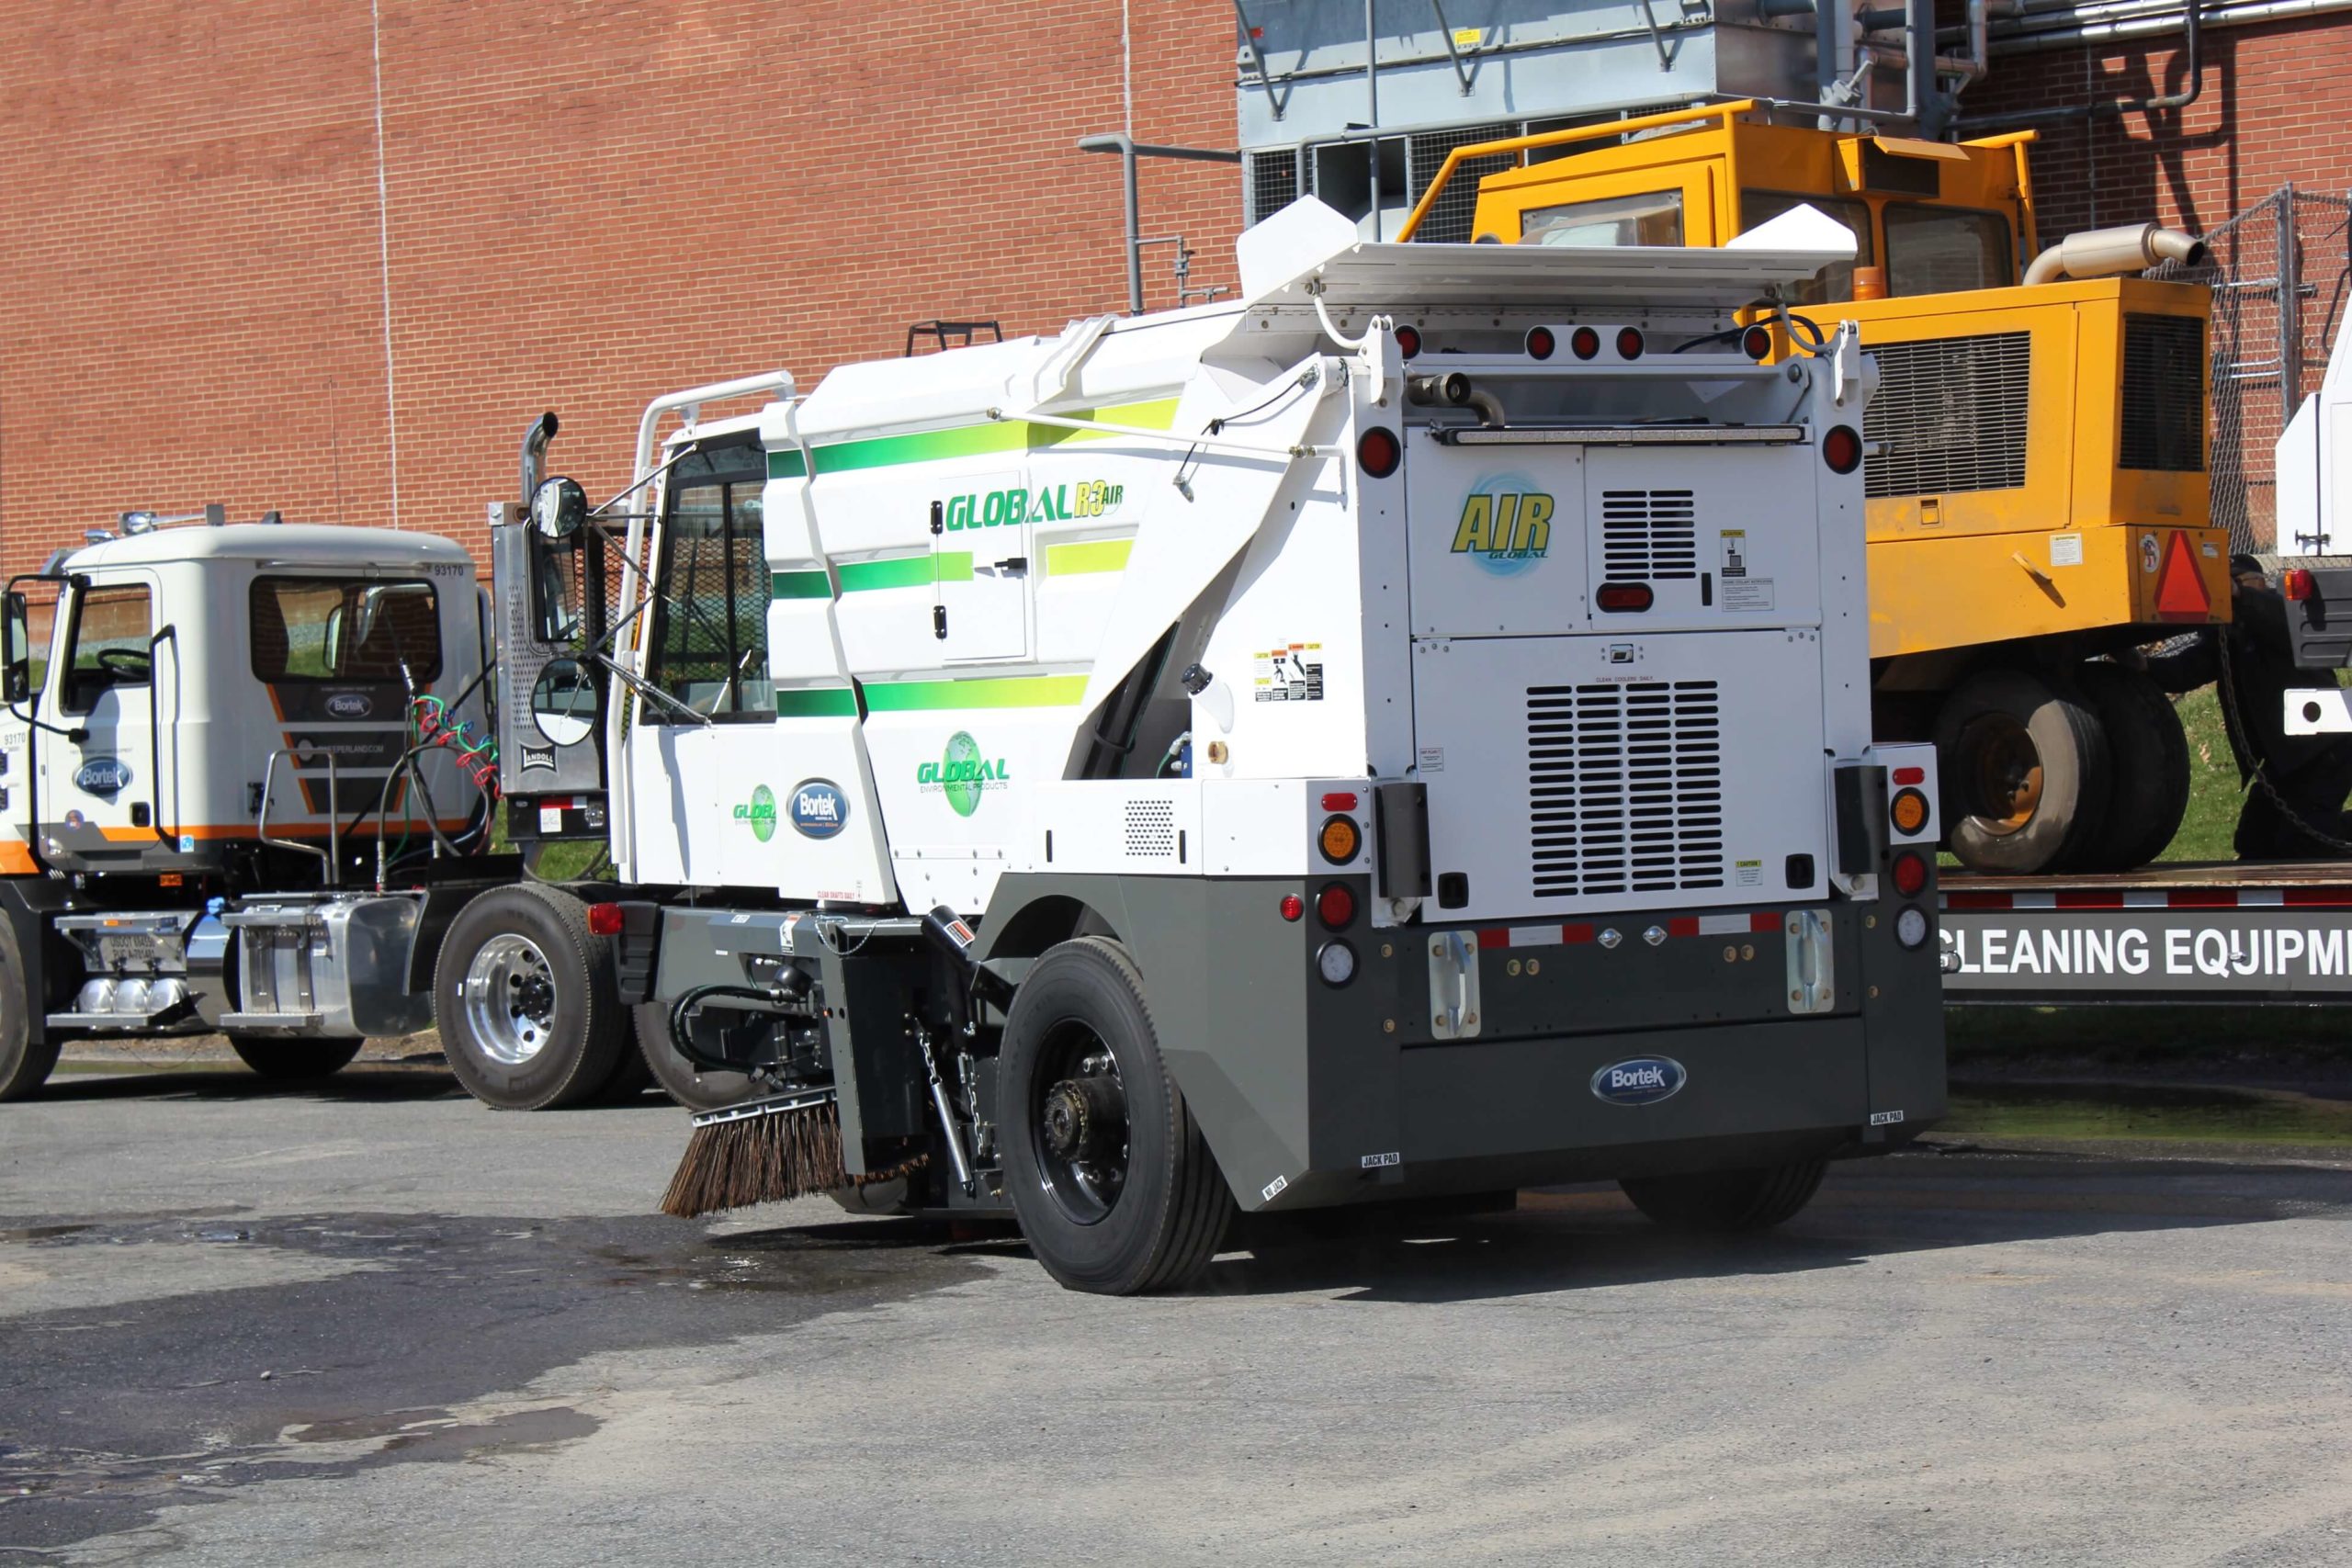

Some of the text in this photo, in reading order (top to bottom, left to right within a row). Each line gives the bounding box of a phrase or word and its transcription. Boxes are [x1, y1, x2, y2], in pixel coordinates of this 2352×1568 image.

[945, 483, 1073, 531] GLOBAL
[1450, 492, 1555, 553] AIR
[1488, 551, 1549, 559] GLOBAL
[434, 565, 464, 576] 93170
[334, 700, 366, 713] Bortek
[4, 732, 26, 745] 93170
[523, 749, 555, 768] LANDOLL
[83, 768, 123, 787] Bortek
[917, 759, 1010, 784] GLOBAL
[799, 793, 838, 820] Bortek
[2165, 928, 2352, 978] EQUIPM
[1611, 1066, 1666, 1088] Bortek
[1363, 1153, 1397, 1167] JACK PAD
